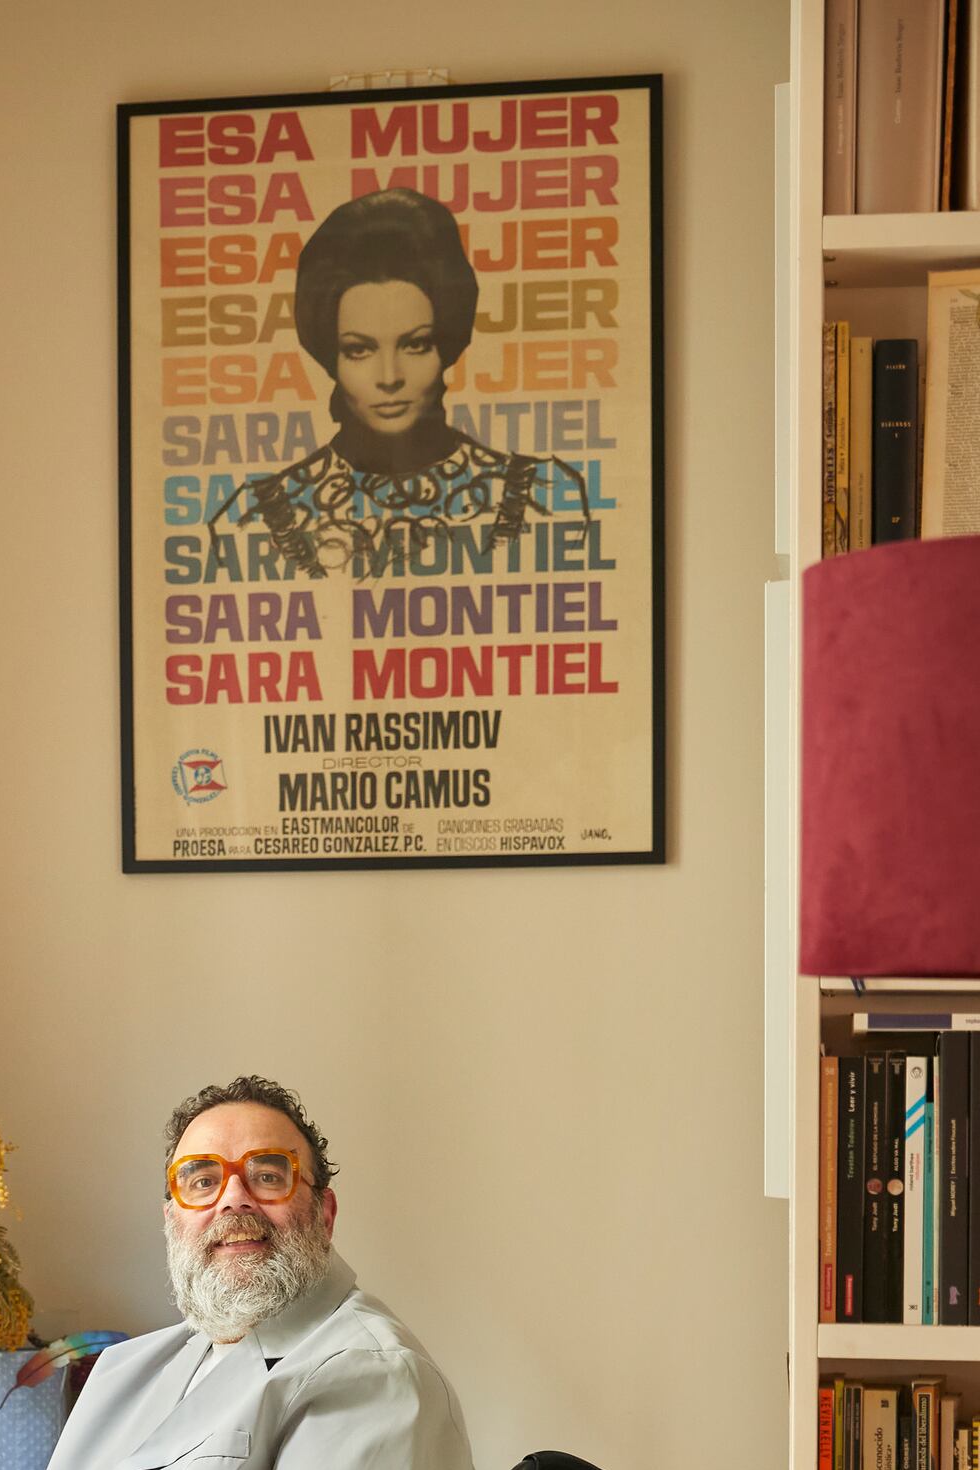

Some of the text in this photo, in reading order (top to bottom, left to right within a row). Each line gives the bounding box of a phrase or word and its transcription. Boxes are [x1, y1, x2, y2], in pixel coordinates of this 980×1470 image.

[159, 95, 619, 167] ESA MUJER
[159, 172, 314, 228] ESA
[160, 216, 619, 287] ESA JER
[161, 278, 619, 347] ESA JER
[162, 338, 618, 406] ESA JER
[162, 399, 617, 467] SARA NTIEL
[164, 520, 617, 585] SARA MONTIEL
[165, 581, 618, 645] SARA MONTIEL
[165, 642, 619, 706] SARA MONTIEL
[263, 709, 502, 754] IVAN RASSIMOV
[322, 755, 423, 770] DIRECTOR
[279, 769, 491, 812] MARIO CAMUS
[173, 839, 227, 857] PROESA
[228, 845, 252, 855] PARA
[254, 837, 319, 855] CESAREO
[176, 816, 415, 838] UNA PRODUCCION EN EASTMANCOLOR DE
[437, 835, 566, 852] EN DISCOS HISPAVOX
[438, 818, 564, 834] CANCIONES GRABADAS
[848, 1096, 856, 1112] Leer
[871, 1217, 879, 1231] Tony
[821, 1396, 831, 1460] KEVIN KELLY
[919, 1398, 927, 1433] liberalismo
[919, 1435, 927, 1445] del
